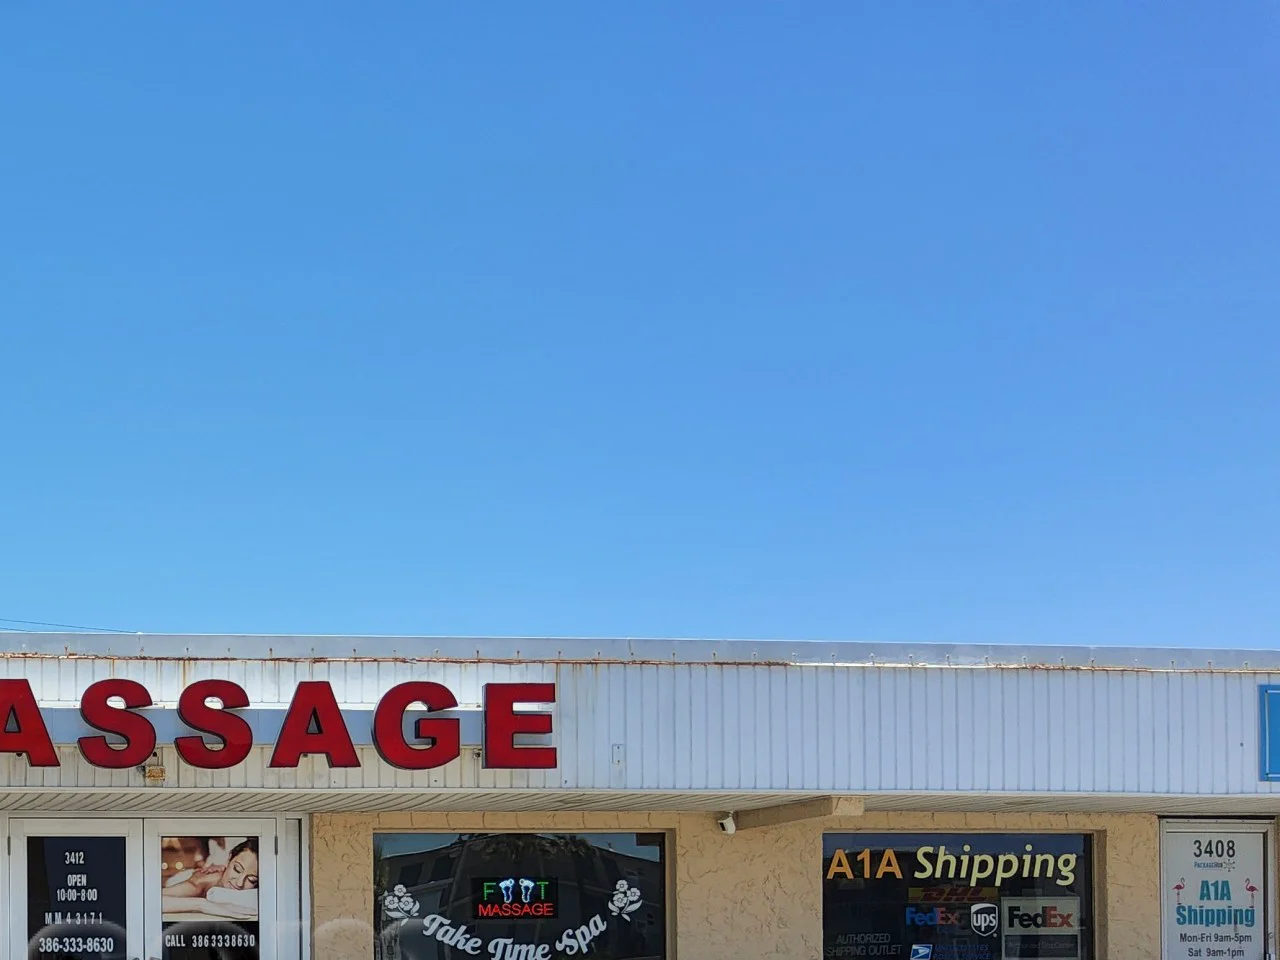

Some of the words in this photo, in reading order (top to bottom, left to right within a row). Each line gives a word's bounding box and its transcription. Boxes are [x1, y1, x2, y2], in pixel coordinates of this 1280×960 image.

[1193, 839, 1236, 858] 3408
[64, 851, 85, 865] 3412
[826, 848, 904, 880] A1A
[913, 844, 1078, 887] Shipping
[67, 874, 87, 887] OPEN
[1199, 880, 1232, 901] A1A
[478, 903, 554, 917] MASSAGE
[905, 906, 960, 926] FedEx
[1007, 905, 1073, 929] FedEx
[1176, 904, 1255, 927] Shipping
[973, 913, 996, 932] ups
[165, 935, 186, 948] CALL
[422, 914, 482, 955] Take
[555, 913, 608, 955] Spa
[836, 933, 891, 944] AUTHORIZED
[1179, 933, 1212, 943] Mon-Fri
[1213, 933, 1252, 944] 9am-5pm
[38, 936, 114, 953] 386-333-8630
[826, 946, 867, 957] SHIPPING
[868, 944, 903, 956] OUTLET
[1188, 948, 1202, 957] Sat
[1205, 948, 1245, 959] 9am-1pm
